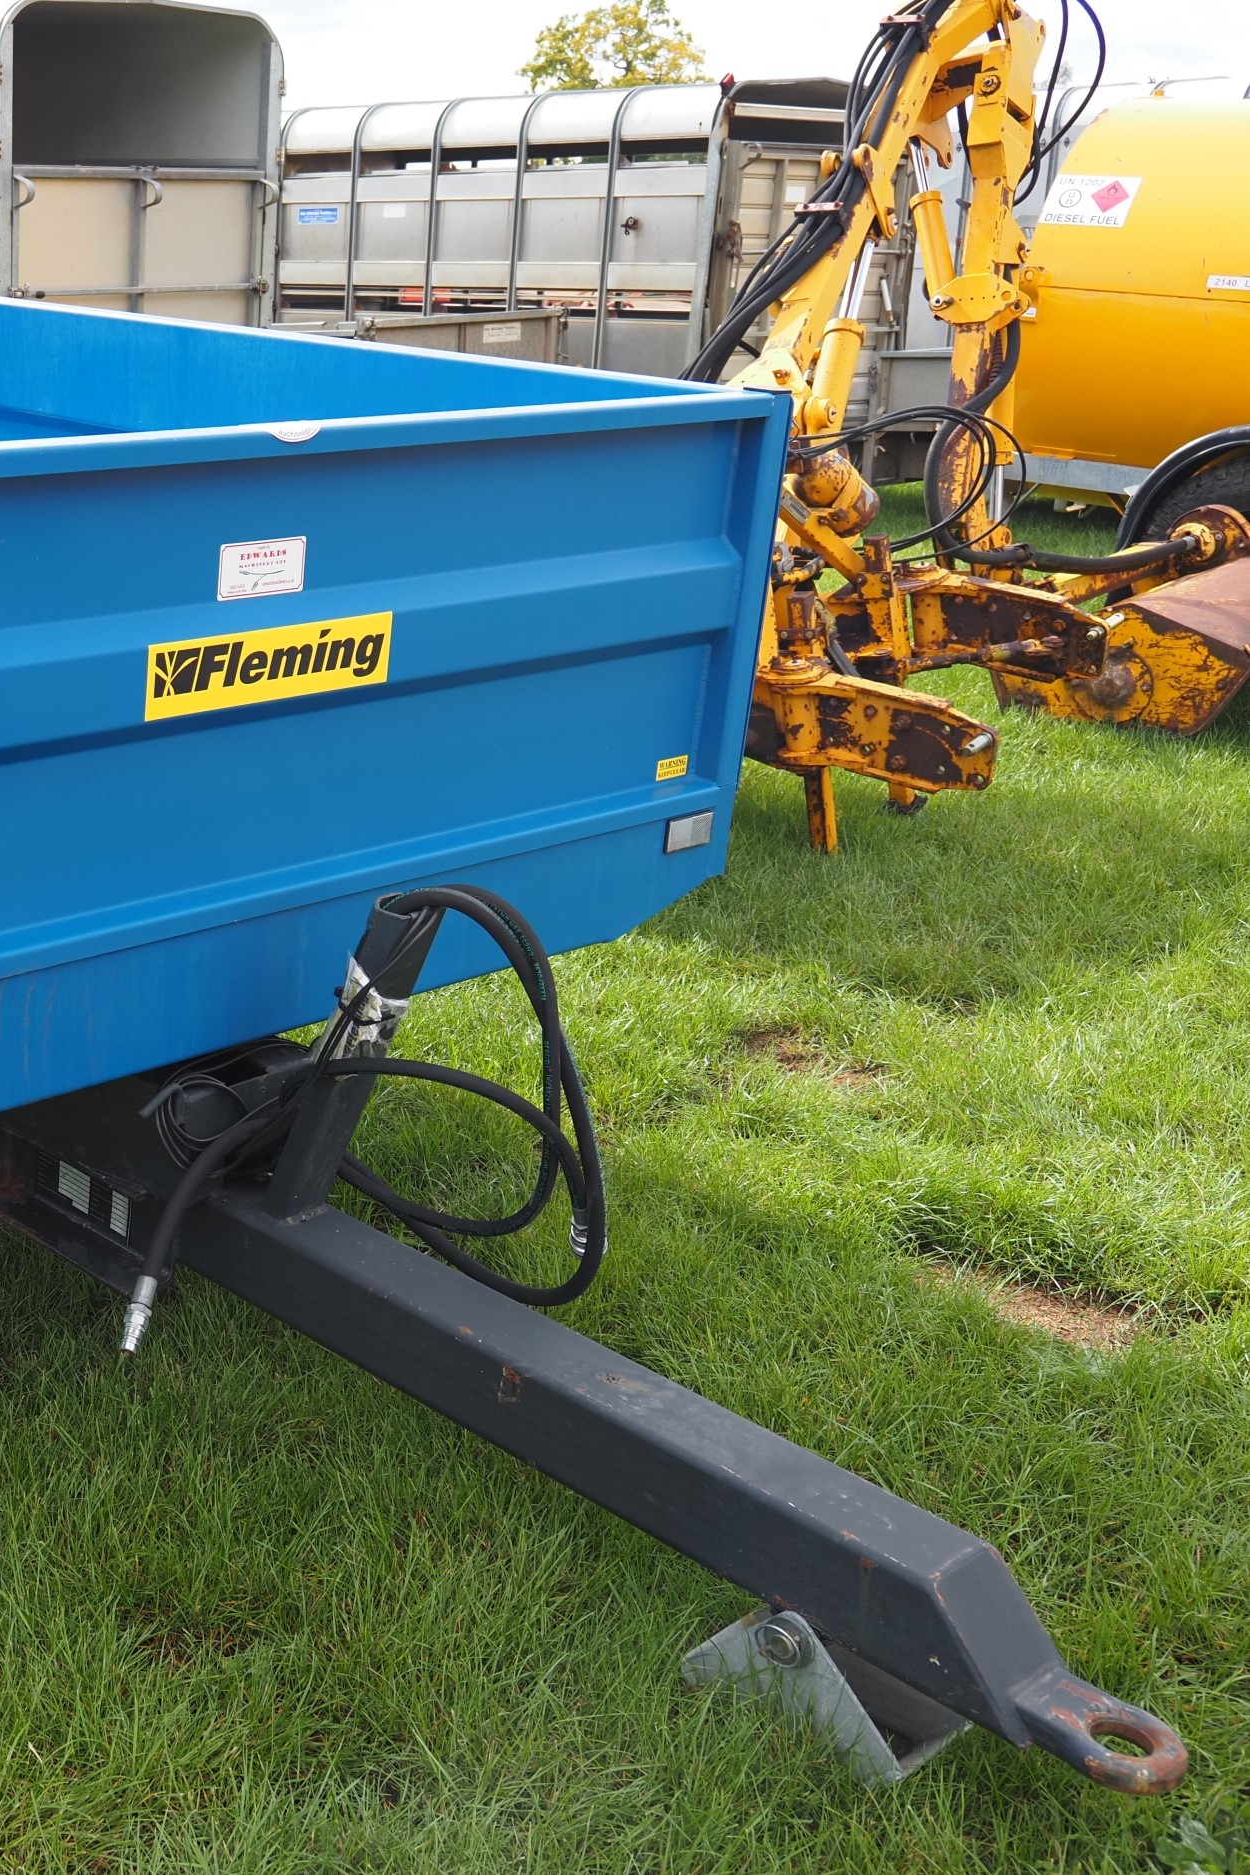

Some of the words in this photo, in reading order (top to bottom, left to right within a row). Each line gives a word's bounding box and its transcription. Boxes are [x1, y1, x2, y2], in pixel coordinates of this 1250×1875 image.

[1059, 177, 1076, 185] UN
[1080, 178, 1105, 187] 1202
[1044, 213, 1086, 224] DIESEL
[1089, 215, 1120, 226] FUEL
[1214, 278, 1238, 287] 2140
[194, 628, 387, 693] Fleming
[659, 757, 686, 768] WARNING
